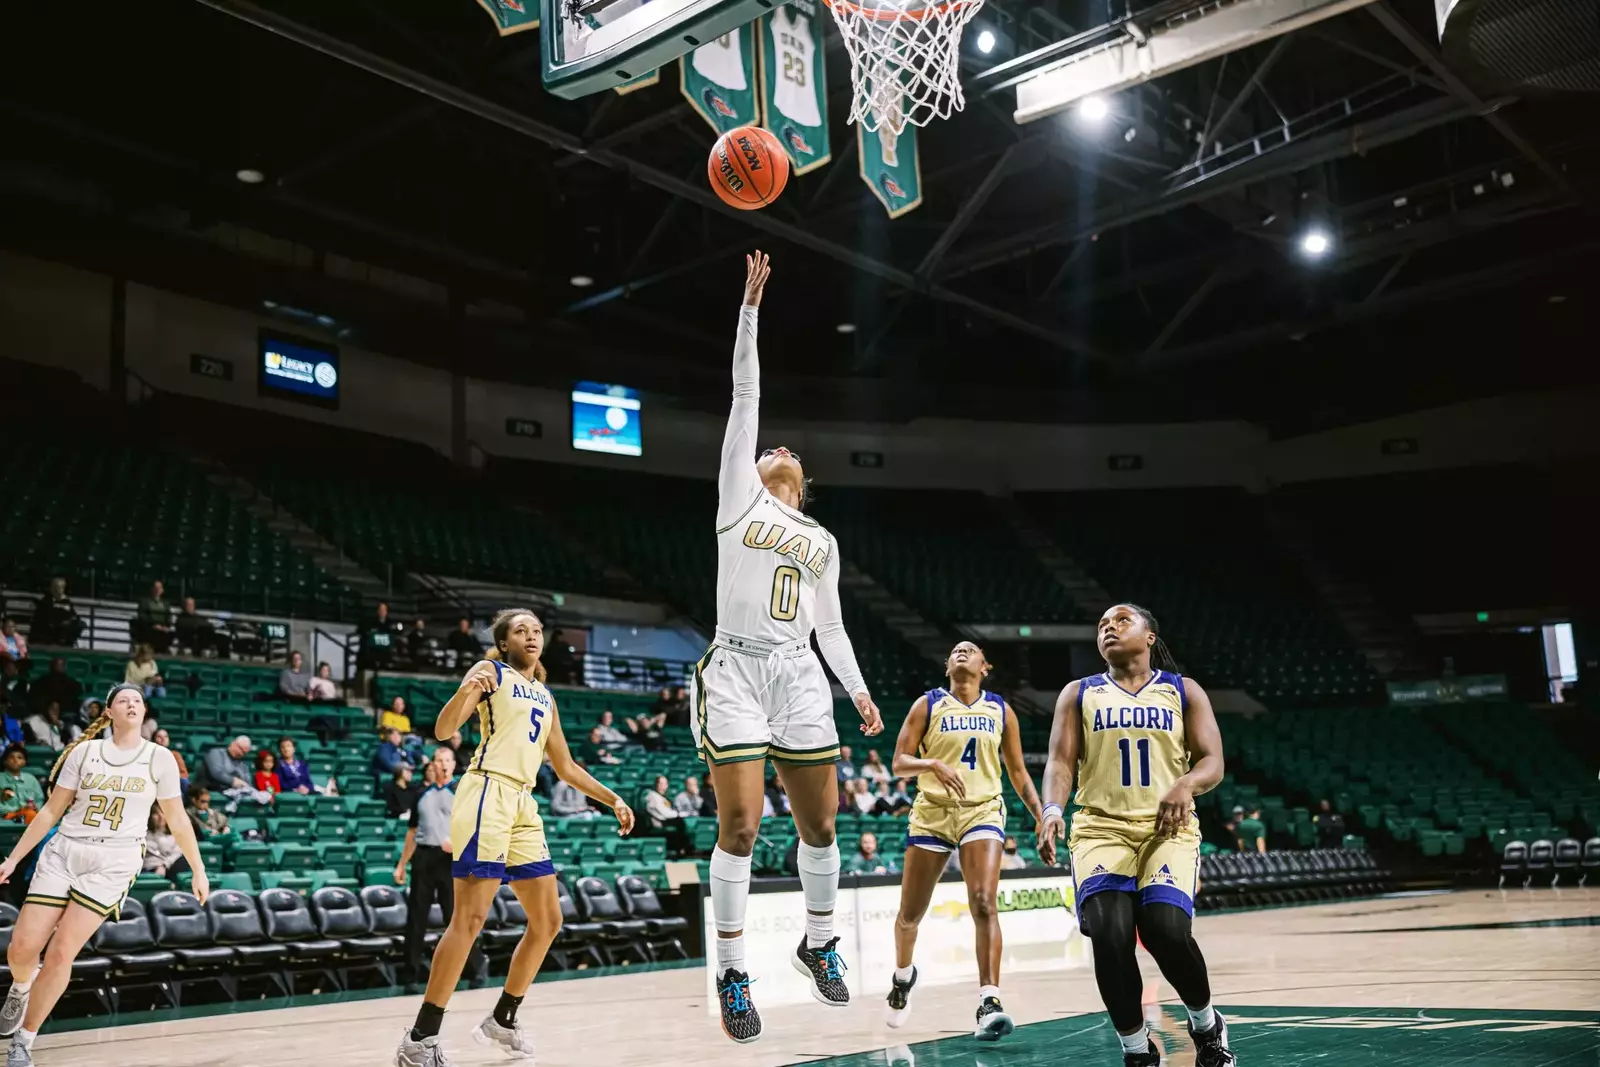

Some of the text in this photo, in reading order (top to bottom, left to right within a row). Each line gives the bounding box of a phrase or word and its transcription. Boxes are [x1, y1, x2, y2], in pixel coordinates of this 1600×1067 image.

[783, 51, 806, 87] 23
[736, 136, 763, 171] NCAA
[742, 521, 827, 579] UAB
[770, 565, 801, 621] 0
[528, 706, 545, 743] 5
[940, 715, 996, 735] ALCORN
[1093, 706, 1174, 733] ALCORN
[960, 737, 977, 770] 4
[1118, 738, 1151, 787] 11
[81, 773, 146, 792] UAB
[82, 795, 126, 831] 24
[997, 887, 1065, 912] LABAMA
